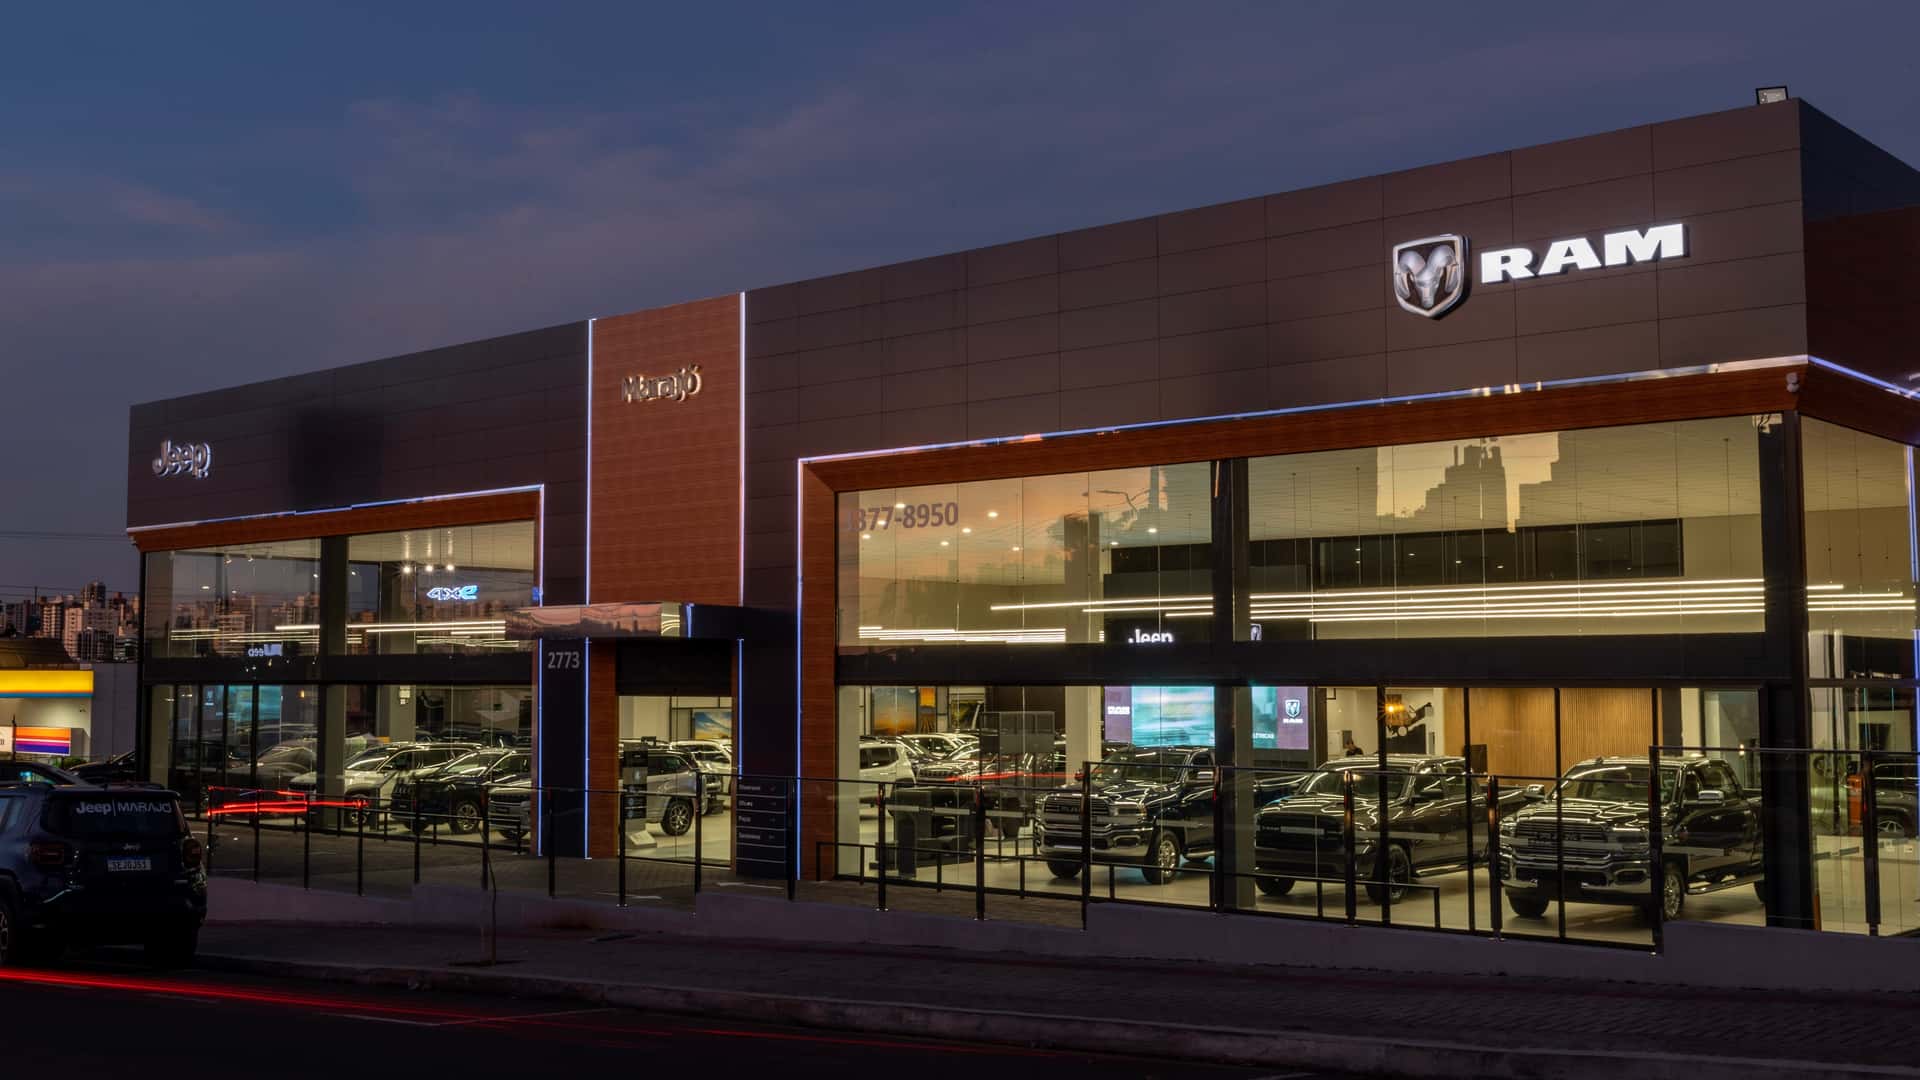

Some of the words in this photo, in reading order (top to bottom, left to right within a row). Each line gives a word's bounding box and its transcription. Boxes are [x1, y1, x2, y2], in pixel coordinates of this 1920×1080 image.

[1481, 223, 1688, 284] RAM
[152, 439, 211, 478] Jeep
[547, 651, 580, 669] 2773
[76, 801, 112, 815] Jeep
